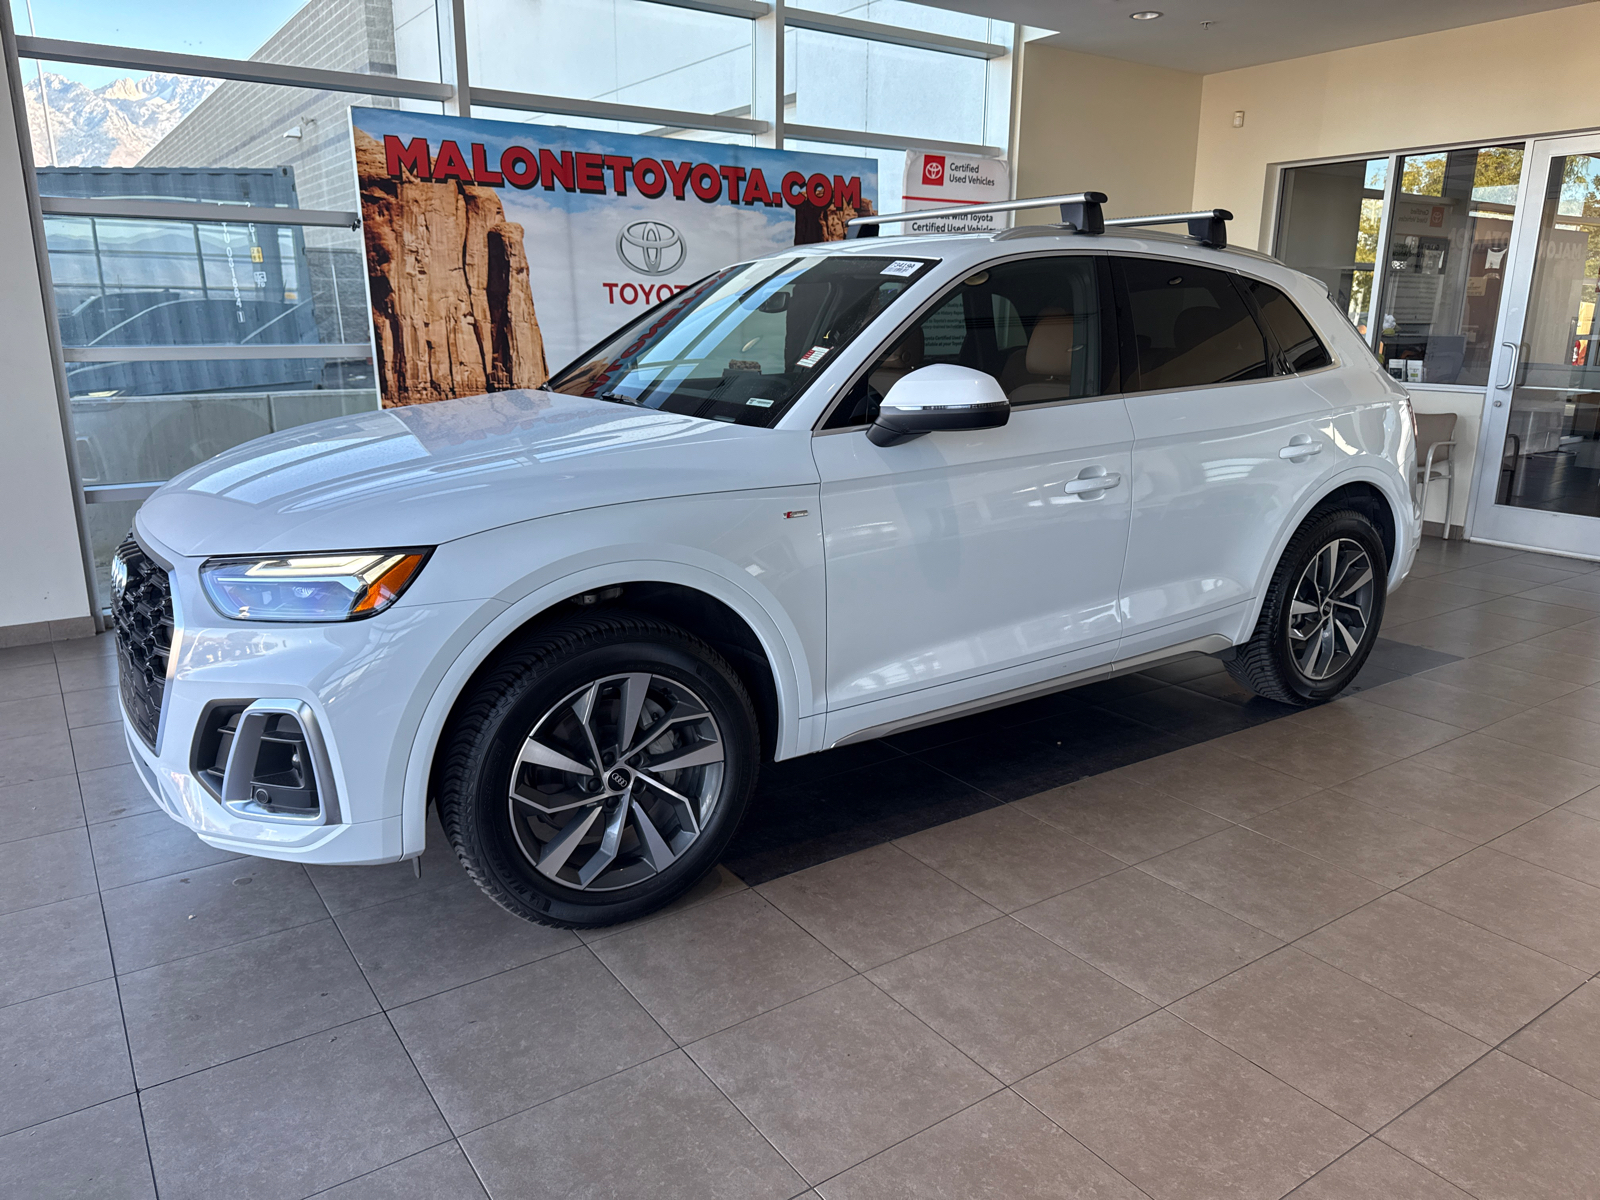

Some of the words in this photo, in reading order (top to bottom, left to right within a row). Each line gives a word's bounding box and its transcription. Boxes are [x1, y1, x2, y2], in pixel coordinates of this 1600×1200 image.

[384, 134, 861, 209] MALONETOYOTA.COM
[949, 162, 979, 173] Certified
[949, 174, 966, 184] Used
[968, 176, 995, 186] Vehicles
[951, 213, 968, 221] with
[970, 213, 994, 223] Toyota
[912, 222, 946, 233] Certified
[947, 224, 966, 232] Used
